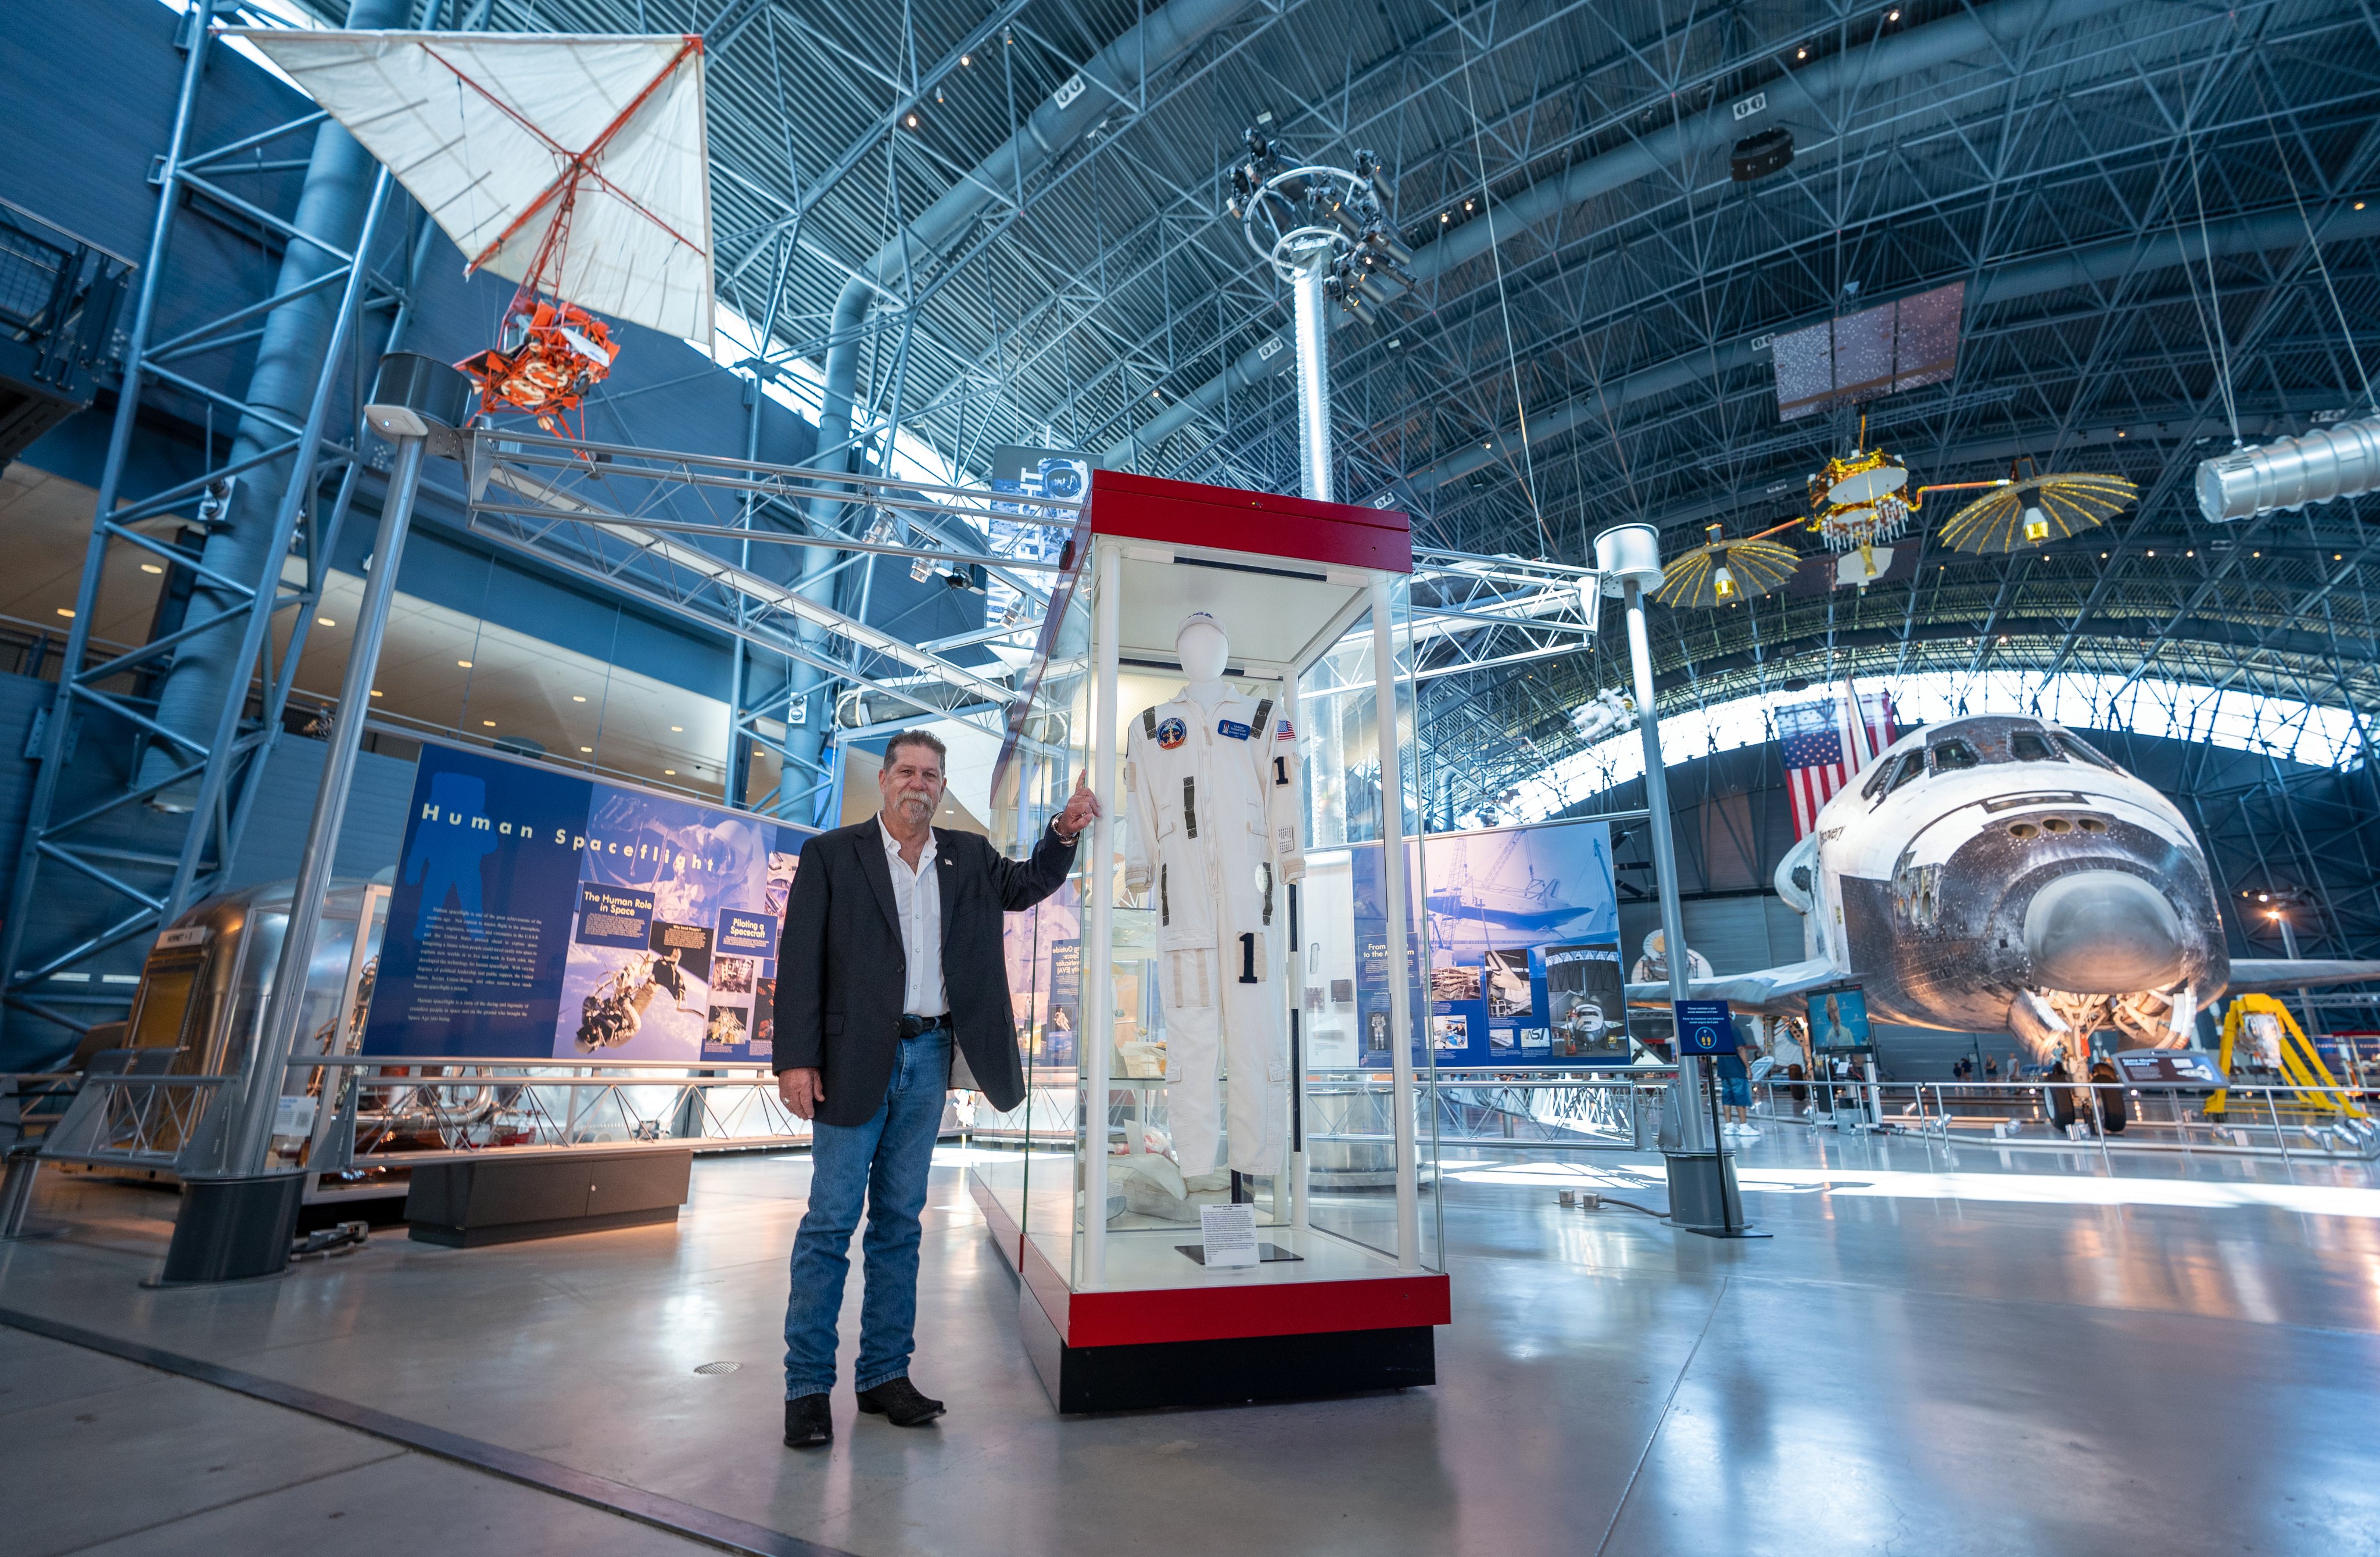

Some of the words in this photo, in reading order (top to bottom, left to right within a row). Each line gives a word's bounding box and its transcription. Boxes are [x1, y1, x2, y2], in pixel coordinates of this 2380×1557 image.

[1274, 756, 1289, 785] 1
[422, 803, 533, 838] Human
[555, 828, 714, 871] Spaceflight
[585, 891, 600, 902] The
[603, 894, 633, 907] Human
[635, 898, 653, 910] Role
[600, 902, 608, 912] in
[610, 904, 635, 916] Space
[730, 925, 765, 938] Spacecraft
[733, 918, 758, 931] Piloting
[1239, 932, 1257, 984] 1
